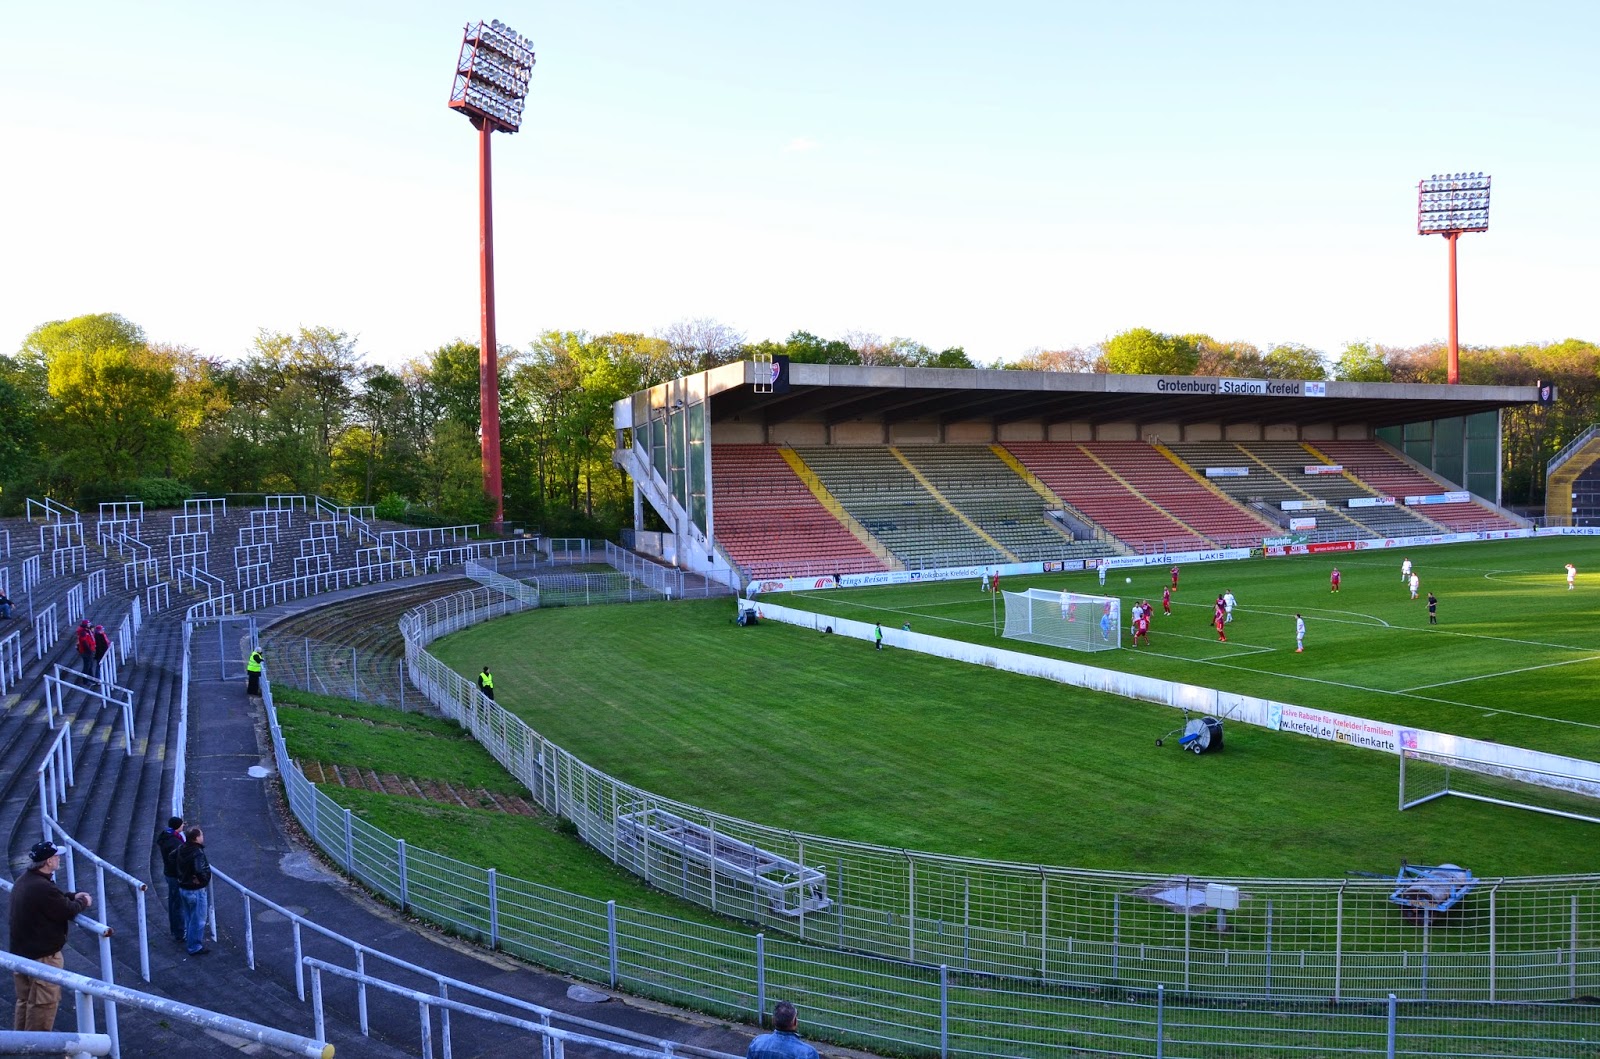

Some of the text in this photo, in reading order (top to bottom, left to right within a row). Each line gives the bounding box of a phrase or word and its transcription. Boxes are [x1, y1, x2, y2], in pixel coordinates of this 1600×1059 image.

[1157, 379, 1217, 394] Grotenburg
[1265, 383, 1300, 394] Krefeld
[1145, 556, 1172, 565] LAKIS
[1199, 552, 1224, 561] LAKIS
[865, 575, 889, 584] Reisen
[921, 571, 949, 580] Volksbank
[950, 569, 969, 577] Krefeld
[1299, 712, 1322, 723] Rabatte
[1322, 716, 1332, 724] für
[1333, 719, 1362, 731] Krefelder
[1364, 725, 1394, 737] Familien!
